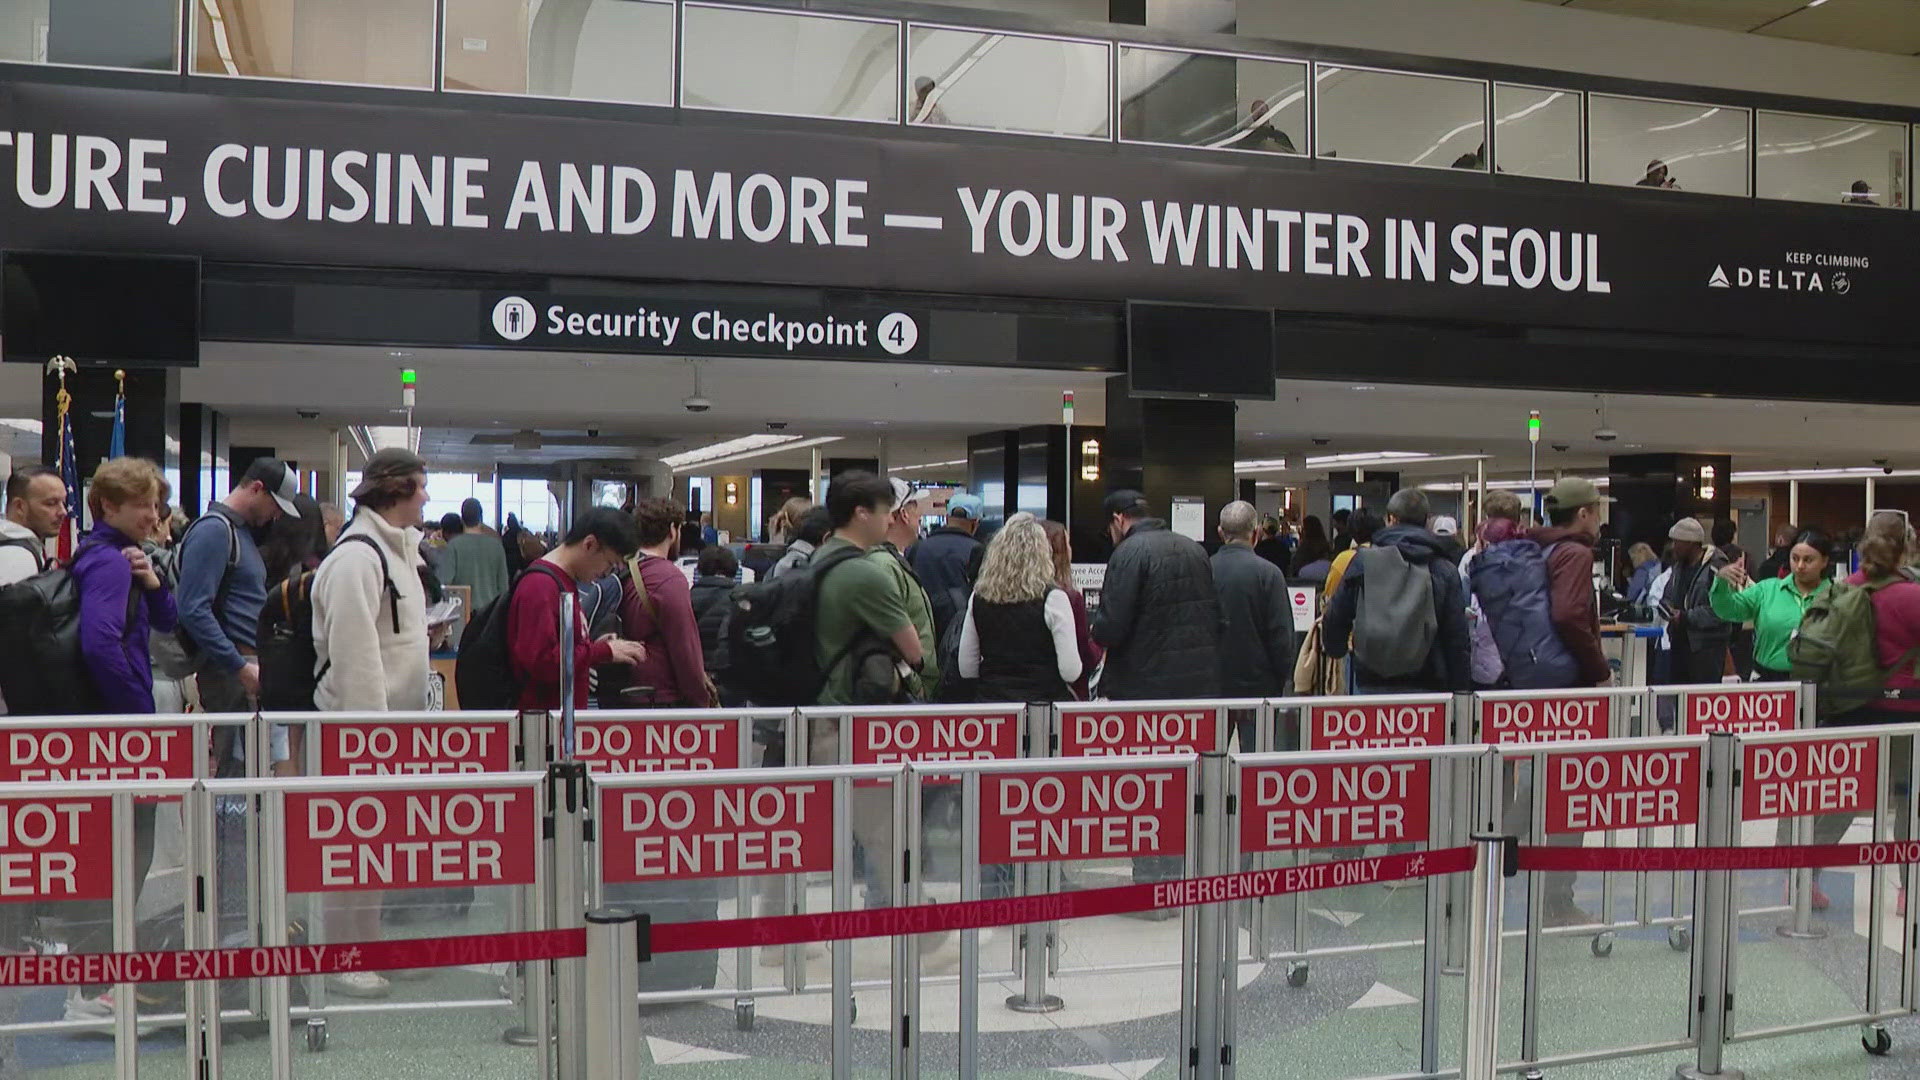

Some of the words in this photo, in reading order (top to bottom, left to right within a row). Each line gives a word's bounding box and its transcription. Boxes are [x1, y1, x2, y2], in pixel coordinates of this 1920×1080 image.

[204, 144, 488, 228] CUISINE
[505, 161, 656, 234] AND
[672, 170, 867, 247] MORE
[957, 187, 1128, 262] YOUR
[1142, 200, 1370, 277] WINTER
[1386, 219, 1435, 281] IN
[1450, 224, 1610, 292] SEOUL
[1786, 251, 1812, 264] KEEP
[1815, 253, 1869, 268] CLIMBING
[1738, 267, 1824, 292] DELTA
[548, 306, 679, 345] Security
[692, 311, 867, 350] Checkpoint
[888, 319, 905, 346] 4
[1324, 710, 1365, 736] DO
[1377, 707, 1435, 734] NOT
[1494, 702, 1533, 728] DO
[1544, 701, 1599, 726] NOT
[1696, 696, 1730, 721] DO
[1739, 694, 1786, 719] NOT
[10, 728, 73, 765] DO
[89, 731, 177, 763] NOT
[340, 727, 397, 758] DO
[413, 727, 495, 757] NOT
[576, 725, 631, 755] DO
[646, 724, 724, 754] NOT
[869, 720, 920, 750] DO
[933, 718, 1005, 747] NOT
[1076, 716, 1124, 744] DO
[1137, 714, 1204, 742] NOT
[1561, 756, 1609, 790] DO
[1622, 752, 1688, 786] NOT
[1754, 747, 1797, 779] DO
[1808, 742, 1867, 775] NOT
[1000, 777, 1065, 815] DO
[1082, 773, 1172, 811] NOT
[1258, 769, 1317, 805] DO
[1333, 764, 1415, 801] NOT
[1759, 777, 1859, 815] ENTER
[0, 803, 91, 846] OT
[309, 797, 386, 838] DO
[407, 794, 515, 835] NOT
[623, 791, 695, 831] DO
[714, 786, 815, 827] NOT
[1266, 804, 1404, 846] ENTER
[1568, 789, 1680, 828] ENTER
[634, 829, 803, 875] ENTER
[1009, 815, 1160, 857] ENTER
[1859, 844, 1888, 864] DO
[322, 840, 502, 885] ENTER
[1153, 870, 1279, 907] EMERGENCY
[1285, 865, 1328, 891] EXIT
[1333, 859, 1382, 886] ONLY
[175, 950, 240, 979] EXIT
[250, 946, 327, 975] ONLY
